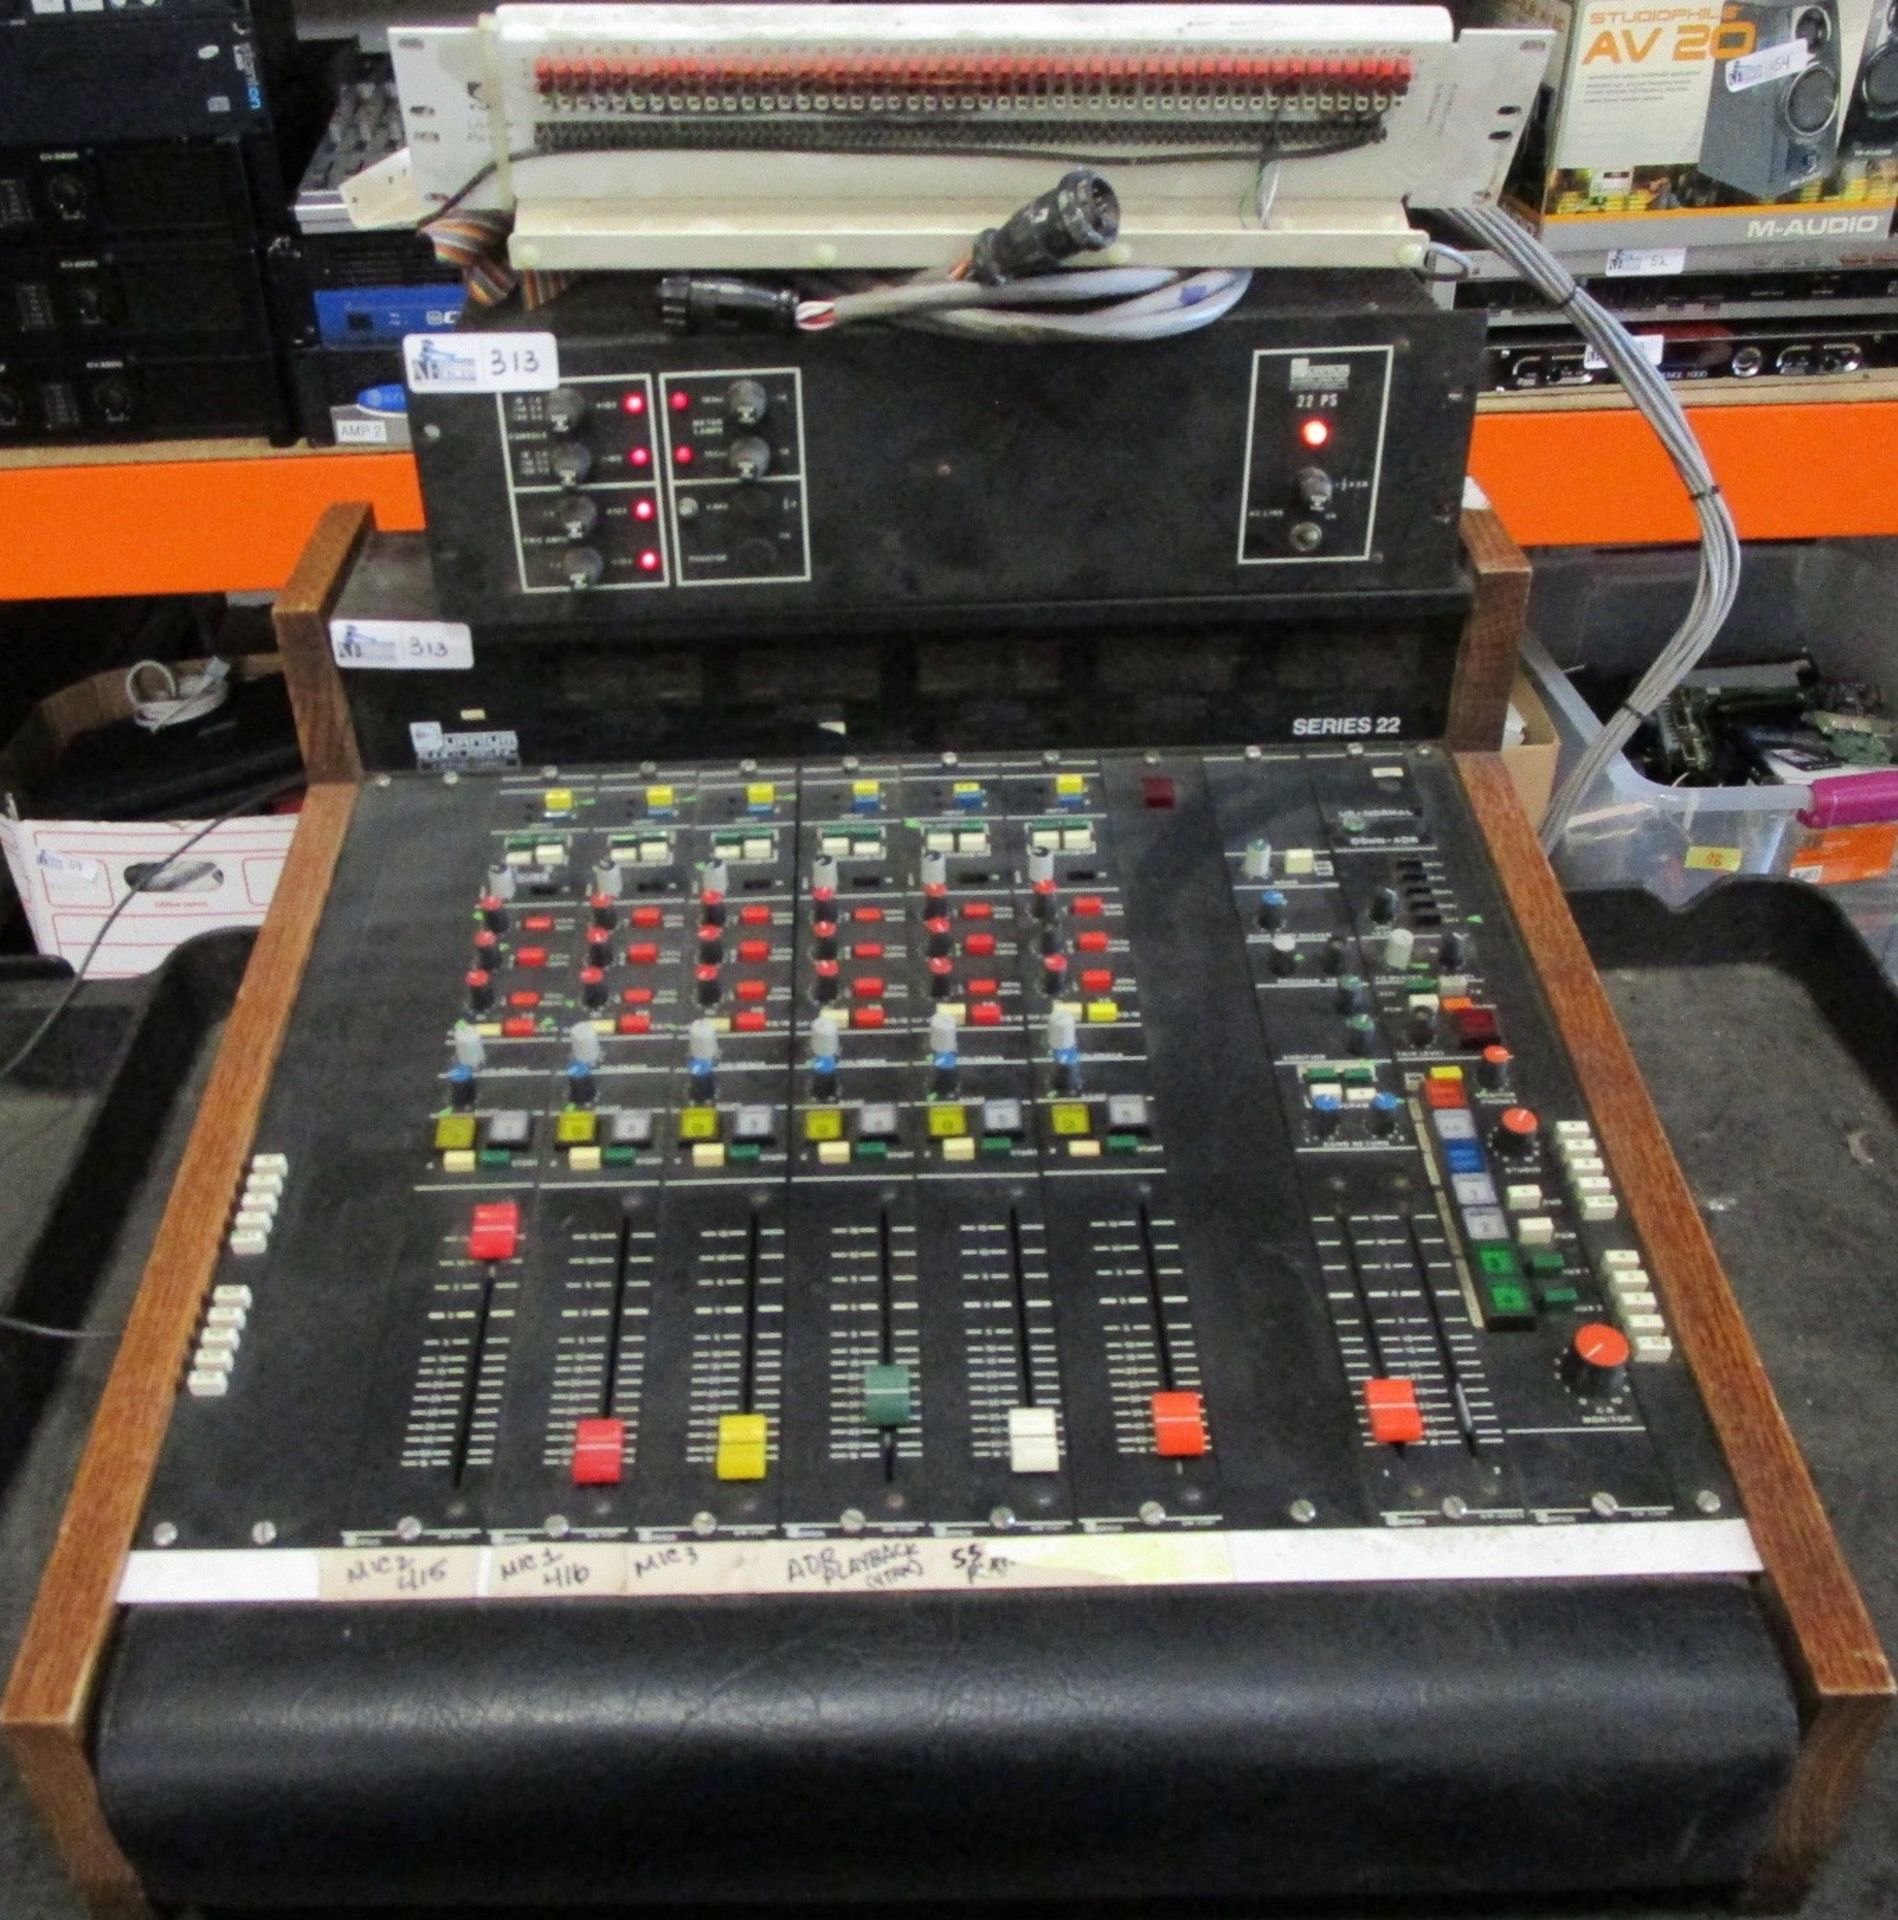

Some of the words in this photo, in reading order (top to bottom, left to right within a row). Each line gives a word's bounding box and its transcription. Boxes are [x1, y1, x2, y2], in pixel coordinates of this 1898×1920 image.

[1581, 27, 1664, 64] AV
[1671, 20, 1757, 61] 20
[1746, 215, 1879, 238] M-AUDIO
[490, 348, 540, 375] 313
[410, 636, 449, 657] 313
[1293, 717, 1372, 735] SERIES
[1375, 717, 1402, 734] 22
